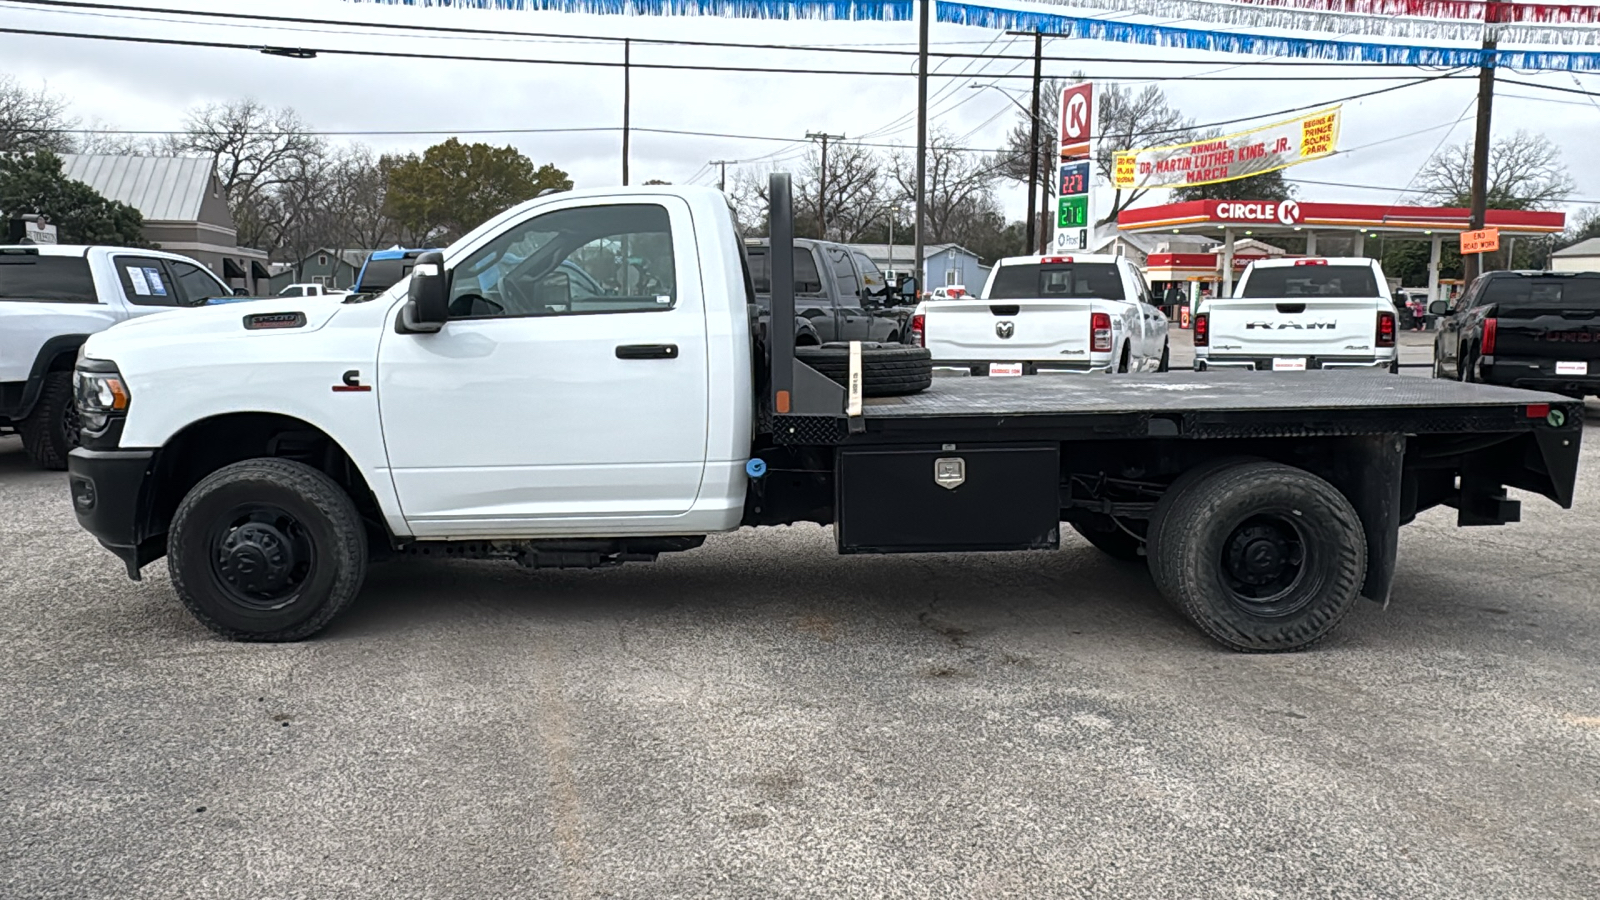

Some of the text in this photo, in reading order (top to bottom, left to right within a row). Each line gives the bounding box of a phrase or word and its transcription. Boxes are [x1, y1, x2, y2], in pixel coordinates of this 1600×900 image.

[1304, 118, 1325, 128] BEGINS
[1305, 123, 1332, 137] PRINCE
[1304, 134, 1330, 146] SOLMS
[1190, 140, 1228, 155] ANNUAL
[1306, 144, 1327, 155] PARK
[1156, 158, 1191, 173] MARTIN
[1194, 150, 1234, 168] LUTHER
[1238, 142, 1267, 160] KING,
[1272, 137, 1291, 153] JR.
[1186, 167, 1228, 183] MARCH
[1216, 202, 1298, 223] CIRCLE K
[1473, 232, 1485, 240] END
[1246, 319, 1337, 329] RAM
